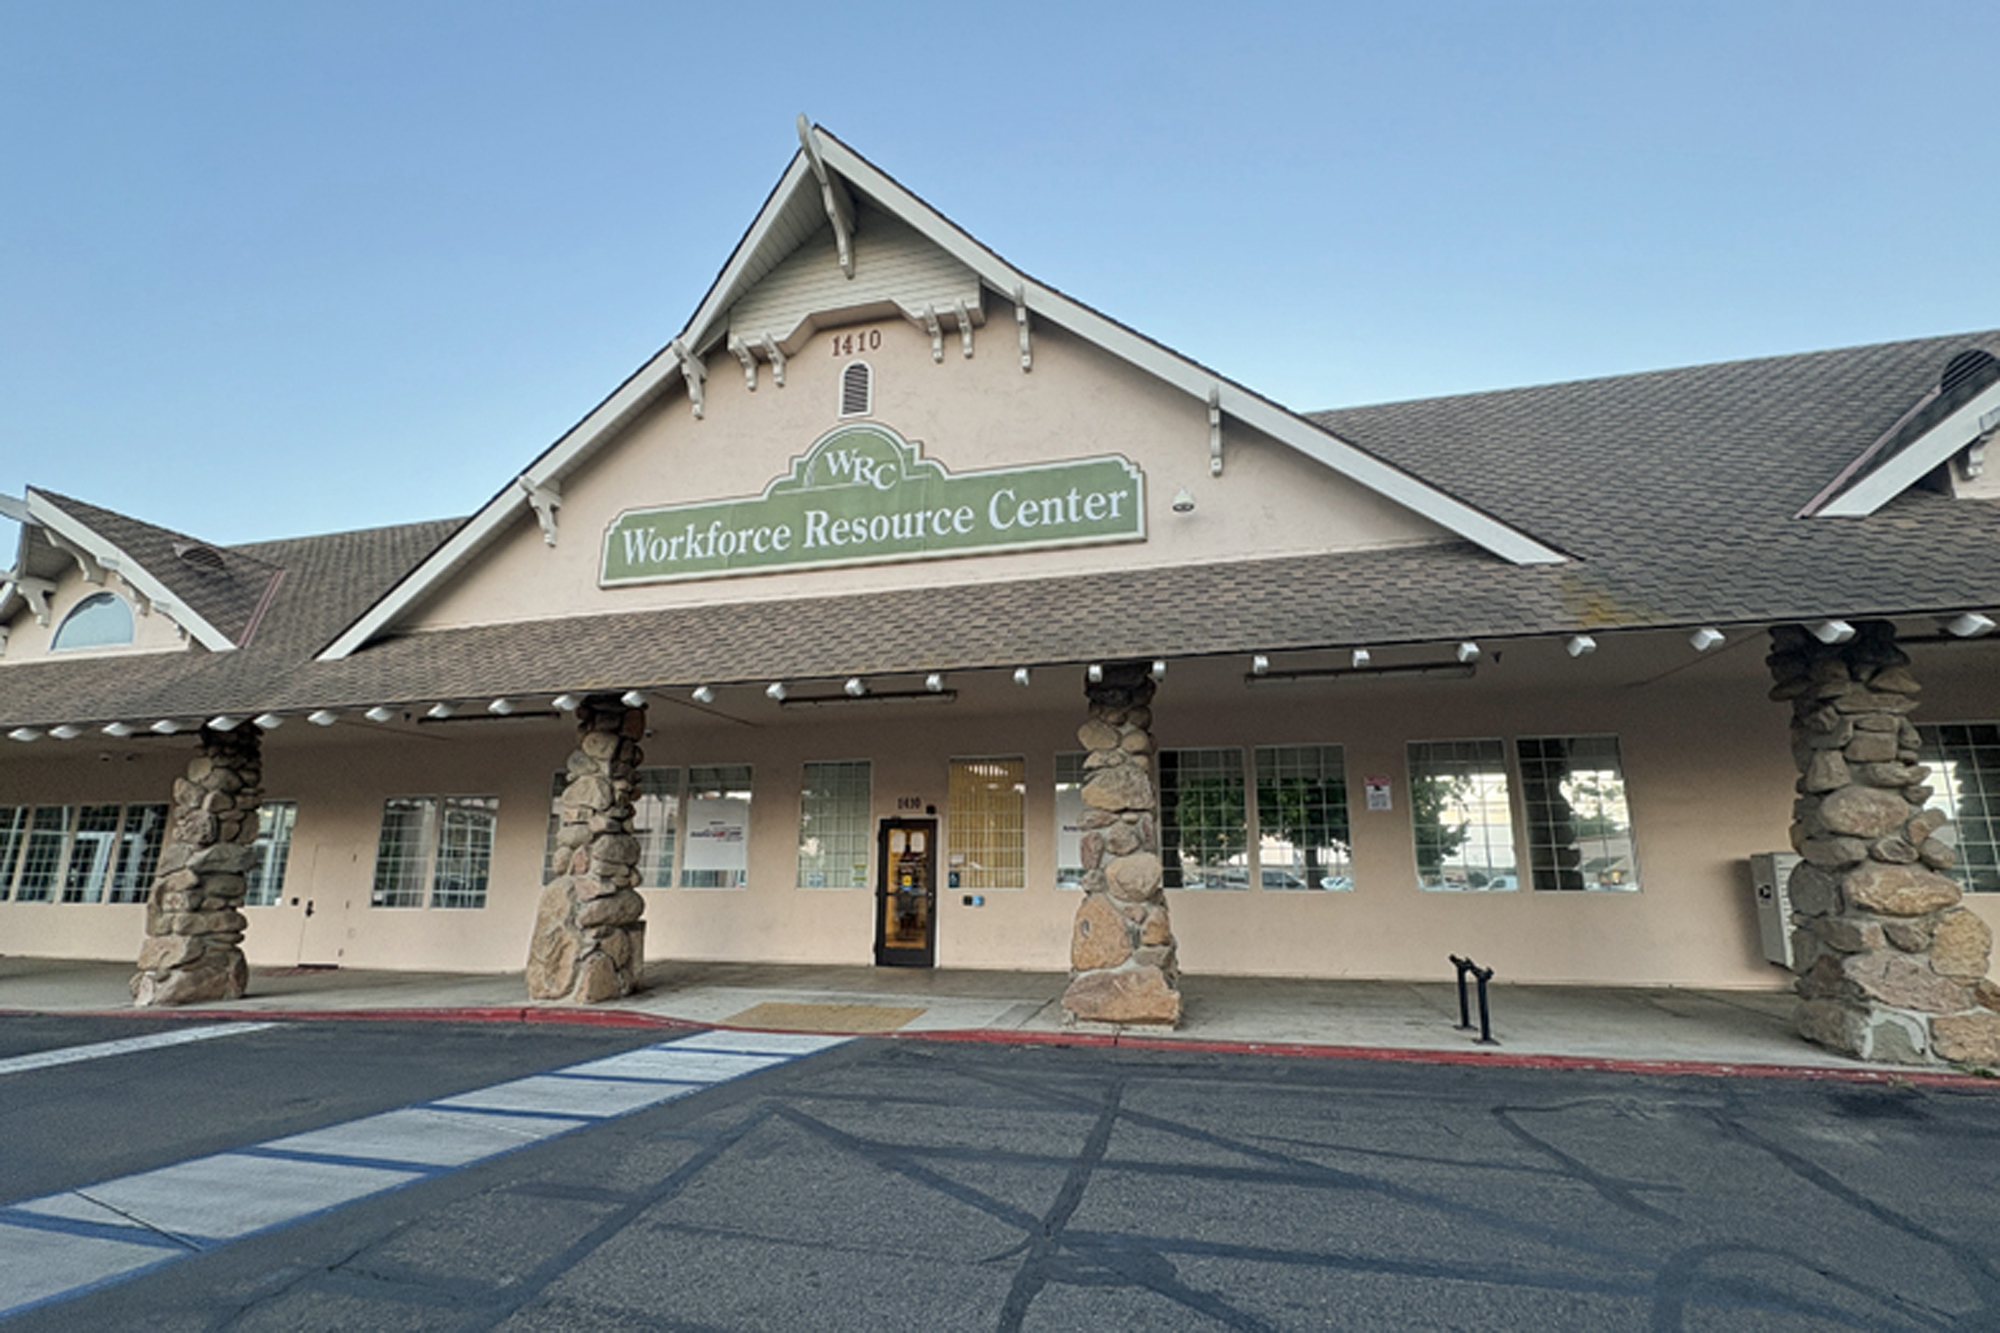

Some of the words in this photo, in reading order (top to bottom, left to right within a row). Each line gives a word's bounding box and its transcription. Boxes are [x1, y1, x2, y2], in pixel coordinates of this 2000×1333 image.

[832, 330, 881, 356] 1410
[824, 447, 896, 490] WRC
[622, 521, 791, 565] Workforce
[803, 508, 974, 549] Resource
[989, 488, 1128, 530] Center
